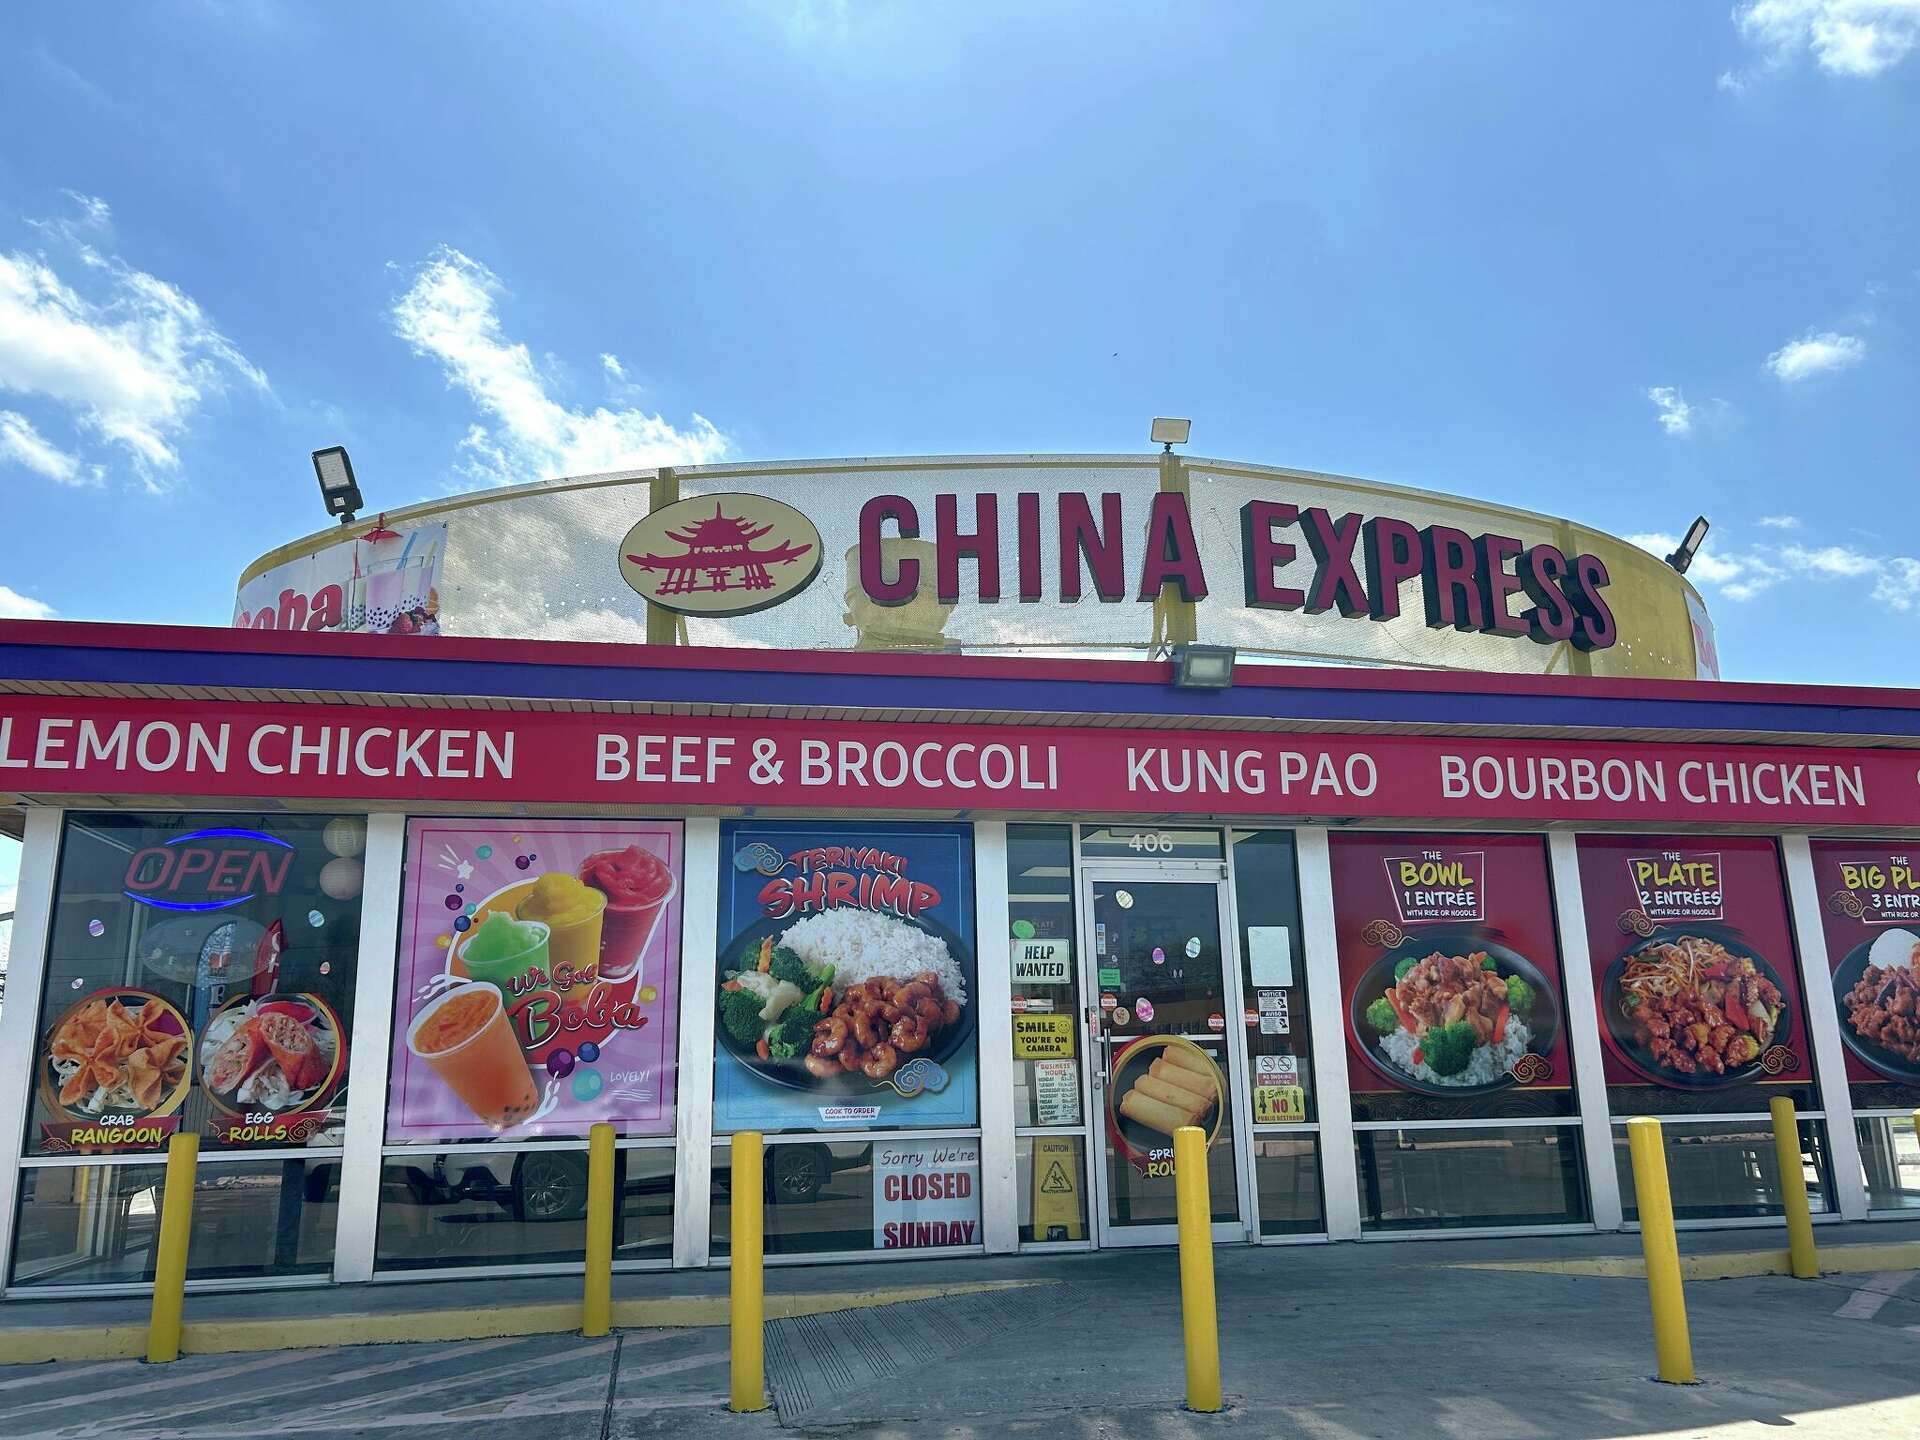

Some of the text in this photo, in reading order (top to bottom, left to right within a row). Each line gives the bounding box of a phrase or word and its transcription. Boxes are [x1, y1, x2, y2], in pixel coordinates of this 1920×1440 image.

[858, 490, 1209, 604] CHINA
[1240, 499, 1617, 652] EXPRESS
[0, 717, 514, 779] LEMON CHICKEN
[596, 733, 1057, 790] BEEF & BROCCOLI
[1127, 747, 1378, 797] KUNG PAO
[1439, 755, 1866, 806] BOURBON CHICKEN
[1129, 833, 1174, 853] 406
[789, 846, 908, 874] TERIYAKI
[1422, 851, 1442, 860] THE
[1662, 852, 1680, 861] THE
[1890, 856, 1908, 865] THE
[124, 847, 295, 893] OPEN
[1400, 862, 1474, 886] BOWL
[1637, 862, 1717, 886] PLATE
[1843, 865, 1886, 889] BIG
[757, 871, 942, 920] SHRIMP
[1404, 891, 1410, 906] 1
[1641, 891, 1652, 905] 2
[1872, 894, 1881, 908] 3
[1025, 946, 1054, 959] HELP
[1016, 963, 1064, 977] WANTED
[506, 982, 649, 1049] Boba
[1016, 1022, 1055, 1033] SMILE
[610, 1069, 650, 1082] LOVELY!
[1268, 1090, 1289, 1099] Sorry
[1272, 1099, 1288, 1113] NO
[99, 1115, 134, 1126] CRAB
[245, 1112, 274, 1125] EGG
[71, 1127, 162, 1144] RANGOON
[229, 1124, 287, 1142] ROLLS
[1043, 1144, 1069, 1153] CAUTION
[1149, 1149, 1174, 1161] SPRI
[881, 1147, 975, 1168] Sorry We're
[884, 1172, 971, 1201] CLOSED
[884, 1220, 975, 1249] SUNDAY
